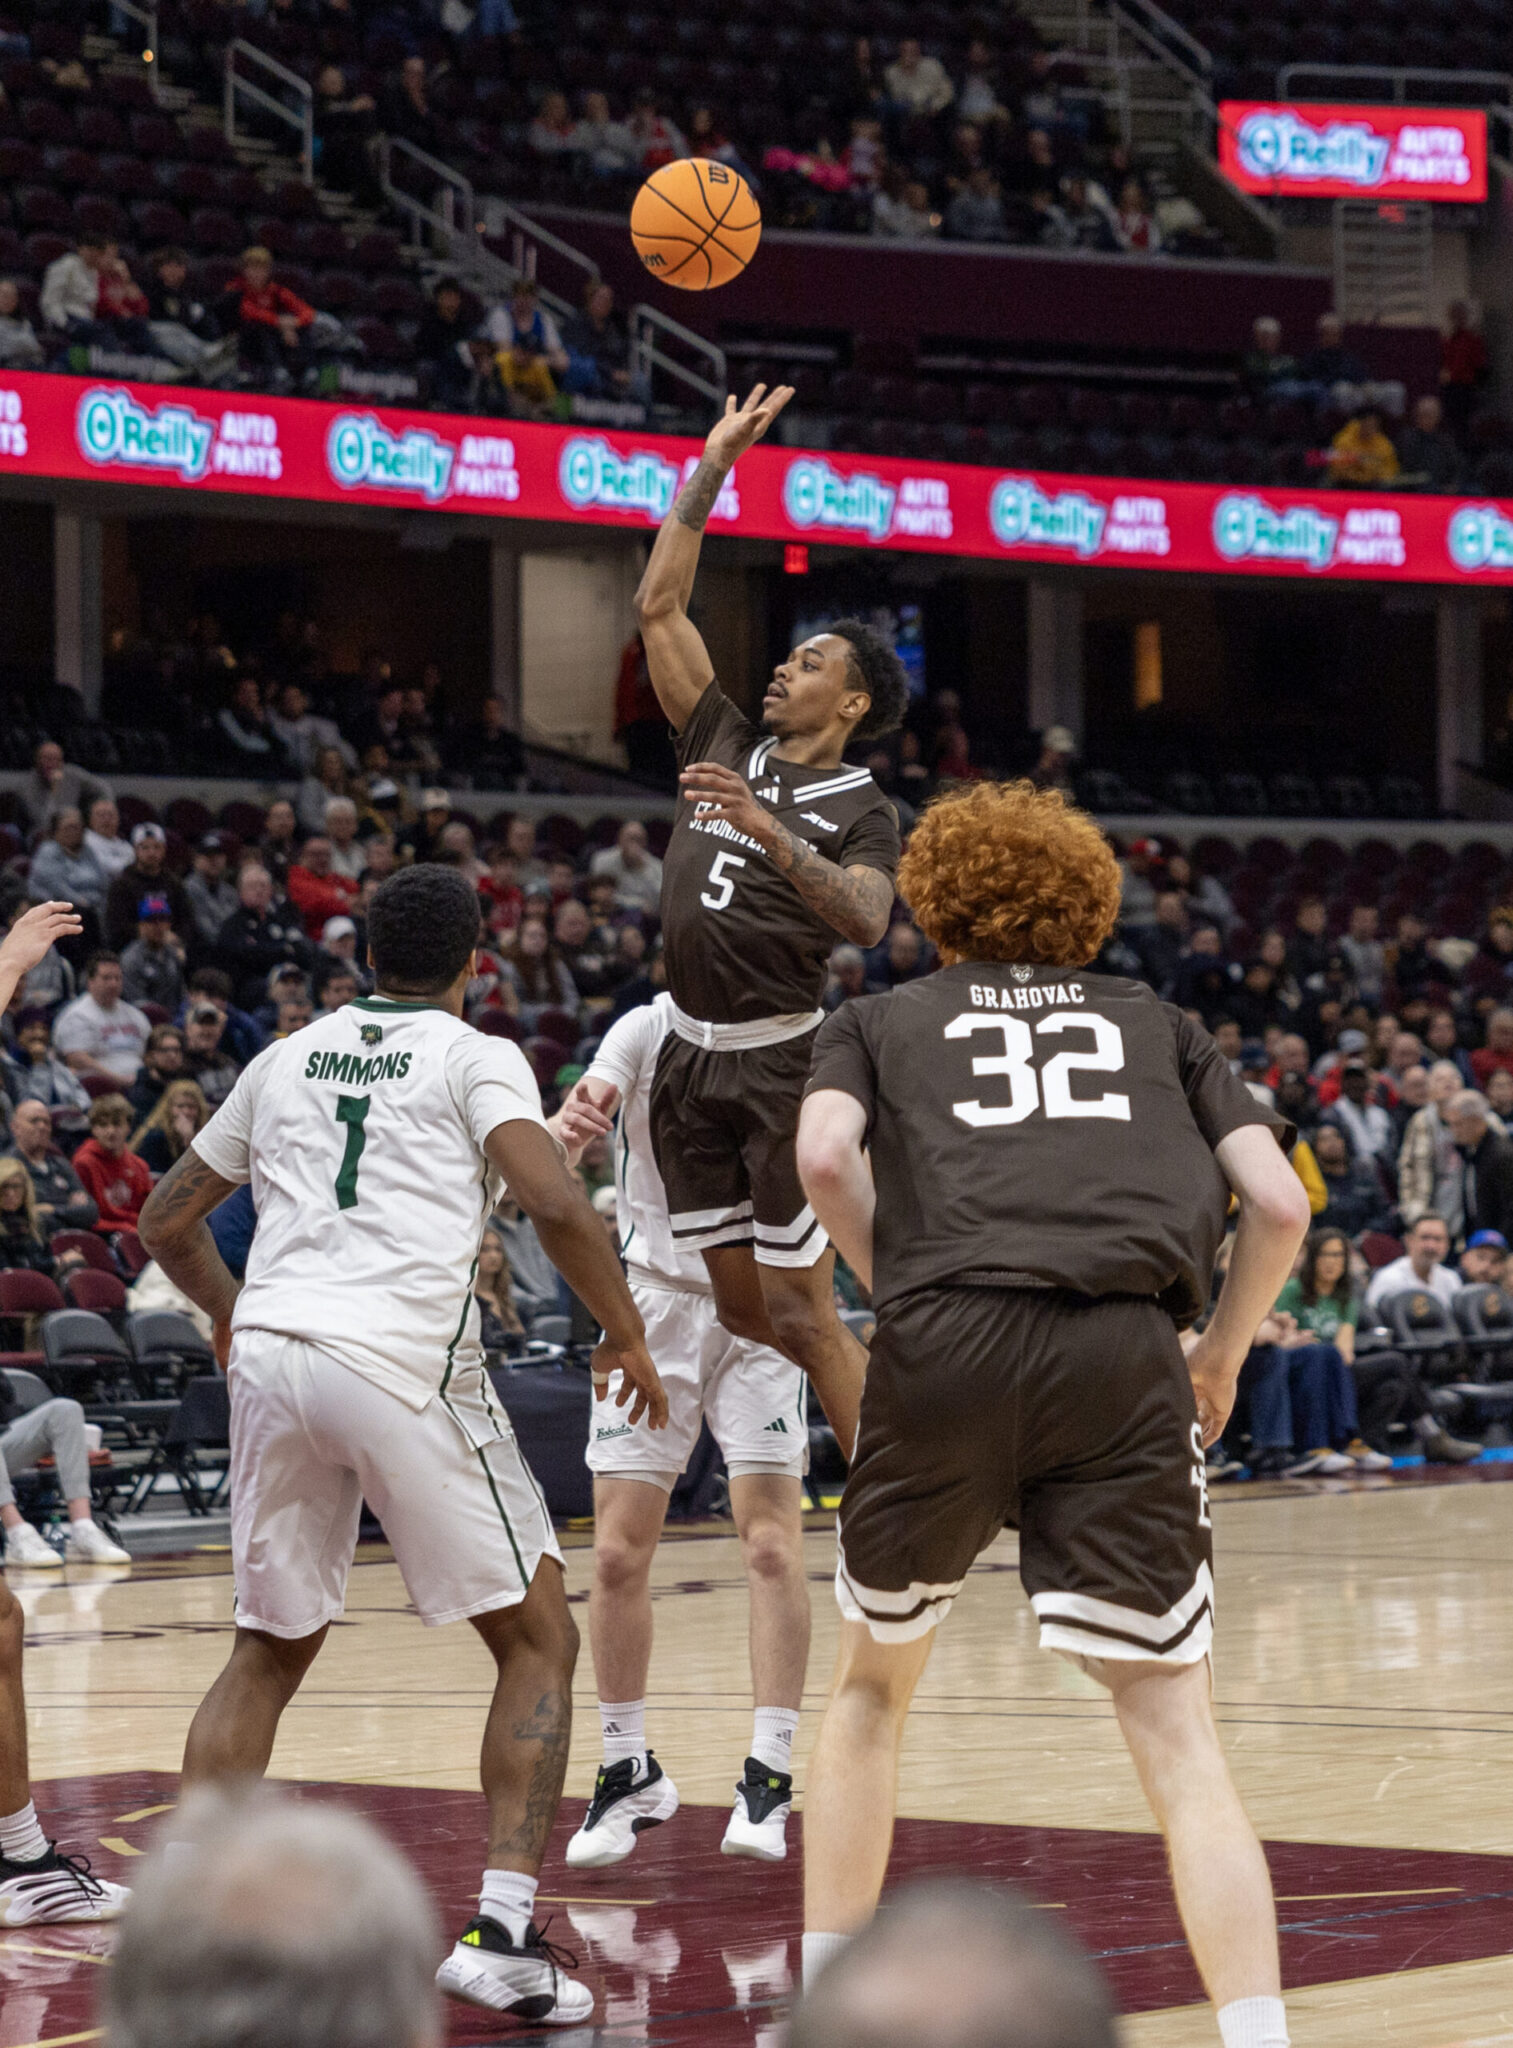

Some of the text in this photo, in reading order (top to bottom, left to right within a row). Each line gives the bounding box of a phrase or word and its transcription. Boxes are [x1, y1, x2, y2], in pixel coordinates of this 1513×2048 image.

[82, 394, 210, 473] O'Reilly
[221, 411, 277, 445] AUTO
[461, 435, 514, 467] AUTO
[213, 442, 282, 480] PARTS
[333, 420, 452, 494] O'Reilly
[565, 441, 676, 515] O'Reilly
[454, 466, 519, 500] PARTS
[701, 850, 746, 911] 5
[970, 983, 1085, 1010] GRAHOVAC
[305, 1051, 412, 1086] SIMMONS
[944, 1011, 1132, 1128] 32
[335, 1094, 371, 1211] 1
